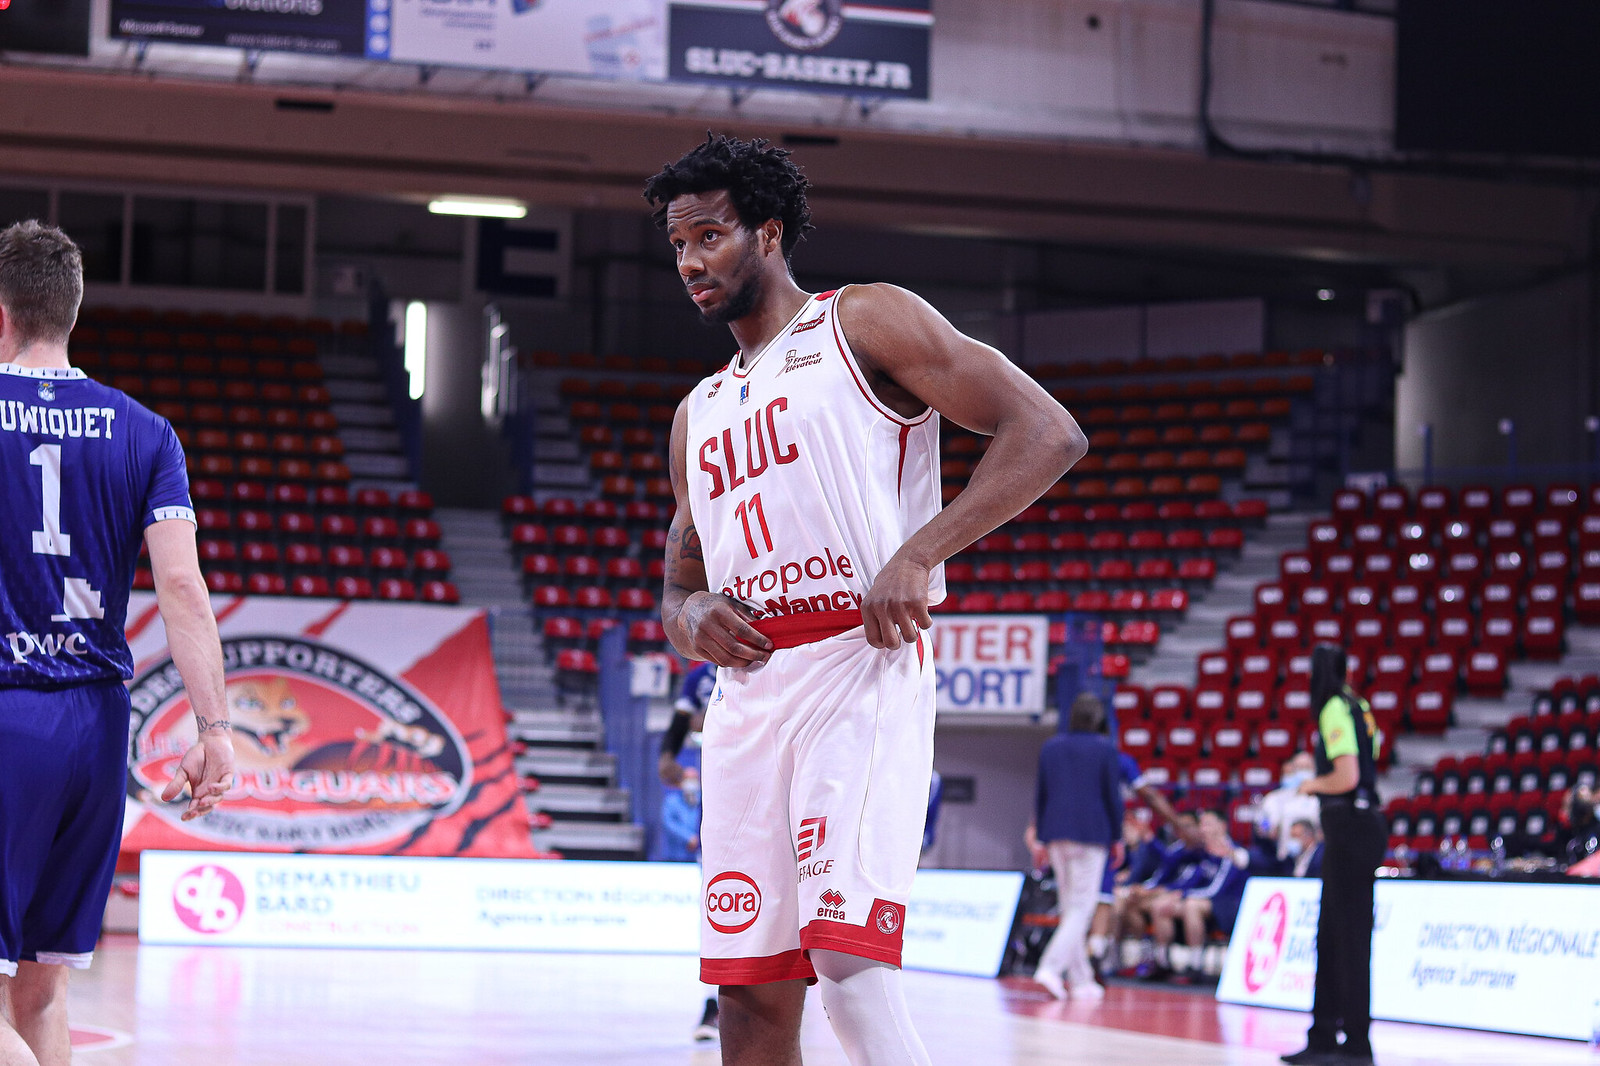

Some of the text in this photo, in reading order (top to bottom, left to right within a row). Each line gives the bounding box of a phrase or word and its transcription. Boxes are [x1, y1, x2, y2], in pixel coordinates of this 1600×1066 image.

[685, 46, 912, 90] SLUC-BASKET.FR
[793, 351, 821, 364] France
[0, 399, 115, 440] UWIQUET
[700, 397, 799, 501] SLUC
[29, 443, 70, 557] 1
[735, 492, 774, 559] 11
[6, 632, 87, 664] pwc
[223, 640, 422, 724] UPPORTERS
[256, 867, 422, 892] DEMATHIEU
[256, 893, 335, 916] BARD
[708, 891, 755, 913] cora
[817, 907, 846, 920] errea
[1418, 921, 1501, 951] DIRECTION
